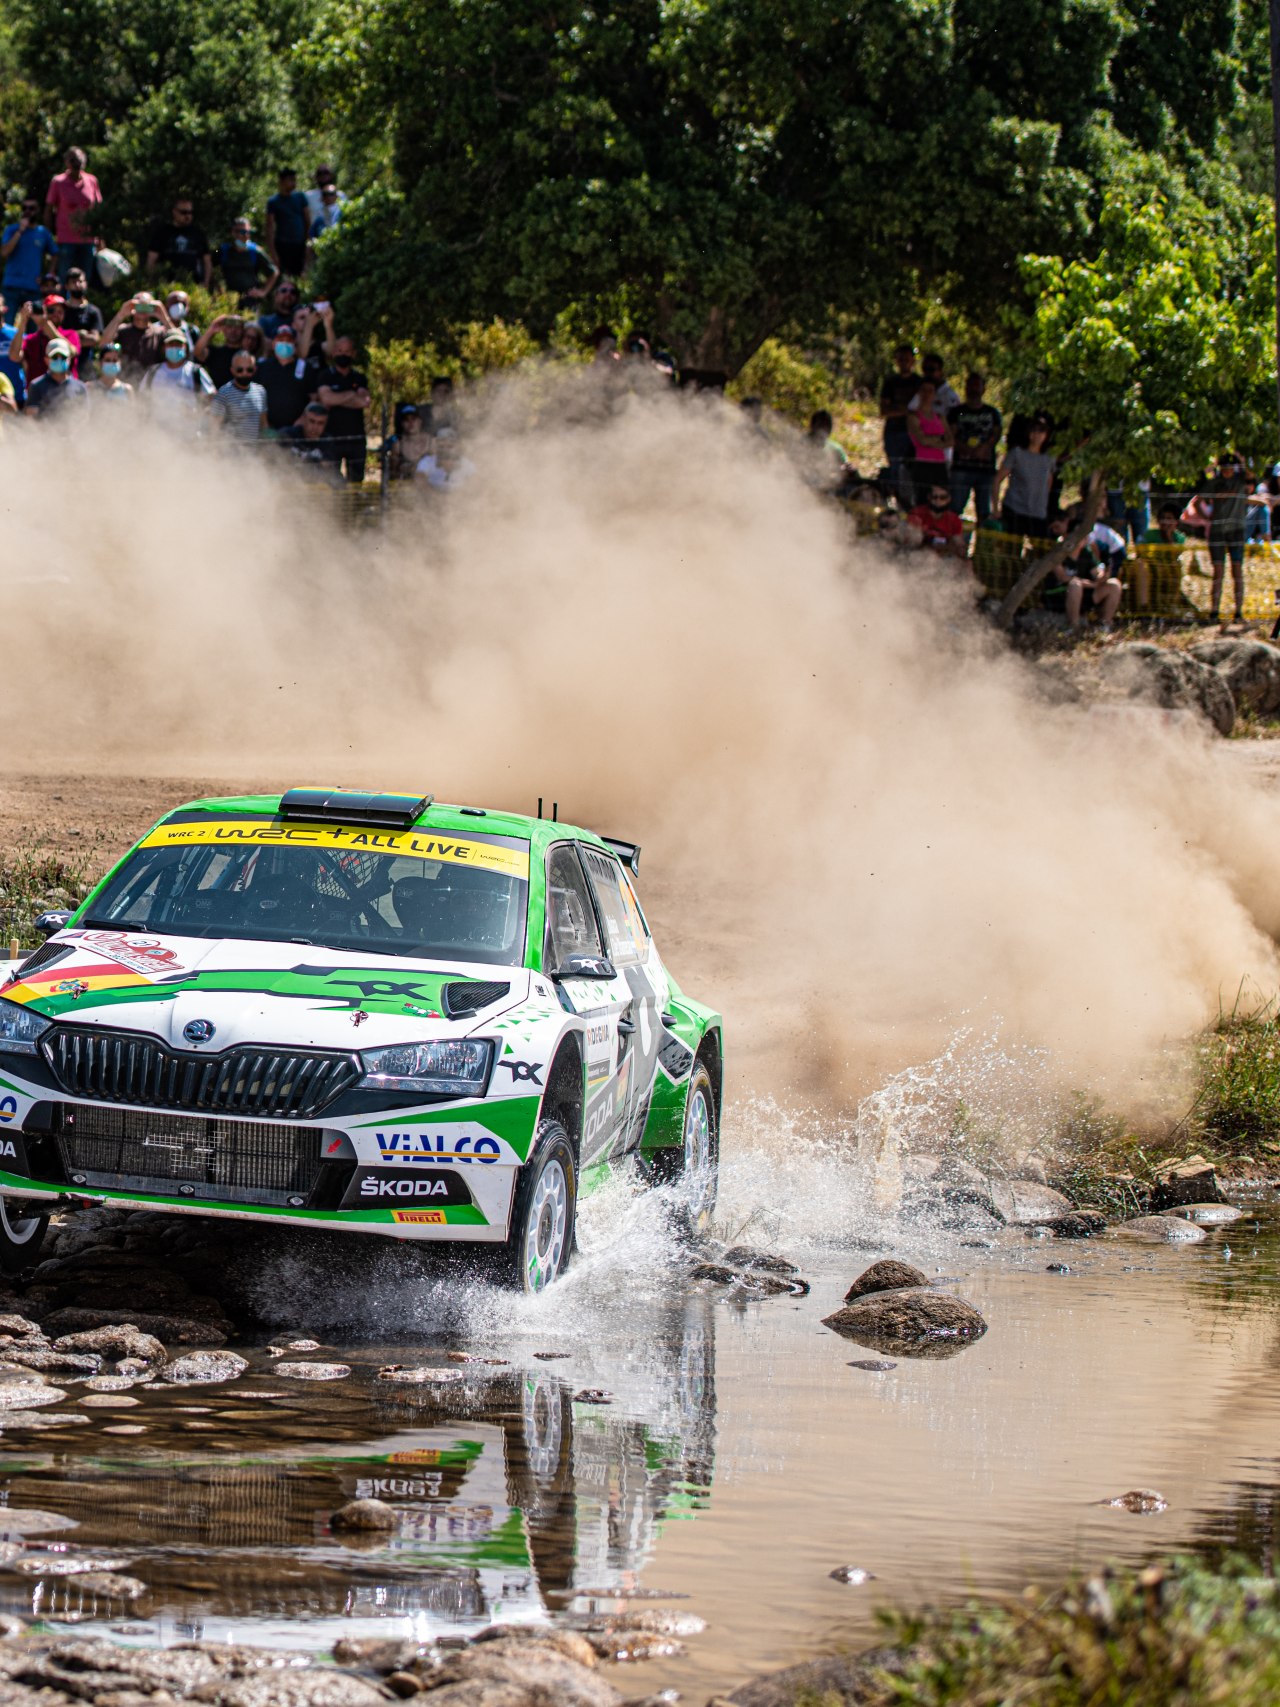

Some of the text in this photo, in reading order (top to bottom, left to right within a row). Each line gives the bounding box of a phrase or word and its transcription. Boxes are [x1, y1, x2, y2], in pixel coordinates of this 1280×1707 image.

[351, 833, 401, 849] ALL
[410, 839, 471, 858] LIVE
[360, 1176, 449, 1196] ŠKODA
[397, 1211, 443, 1223] PIRELLI
